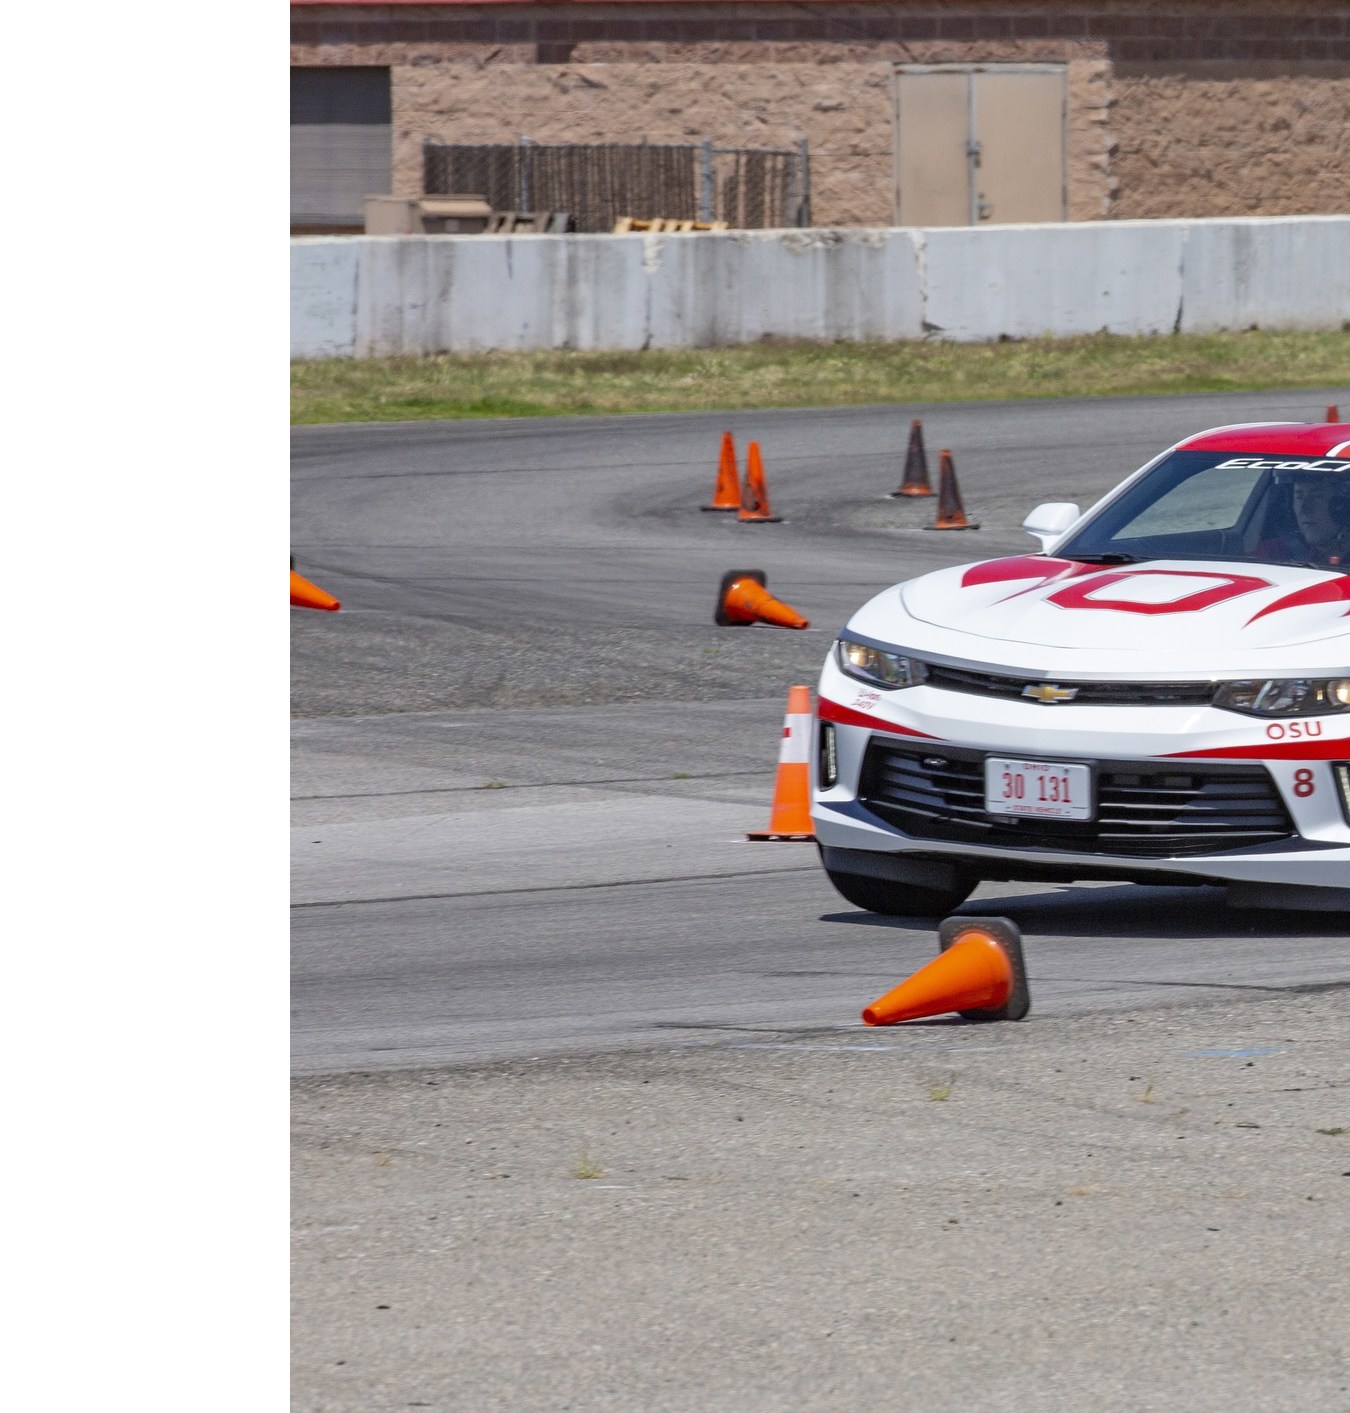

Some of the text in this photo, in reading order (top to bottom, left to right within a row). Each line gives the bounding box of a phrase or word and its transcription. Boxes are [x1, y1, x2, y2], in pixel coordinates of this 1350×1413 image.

[1266, 721, 1323, 740] OSU
[1023, 763, 1050, 772] OHIO
[1002, 772, 1072, 803] 30 131
[1293, 768, 1315, 798] 8
